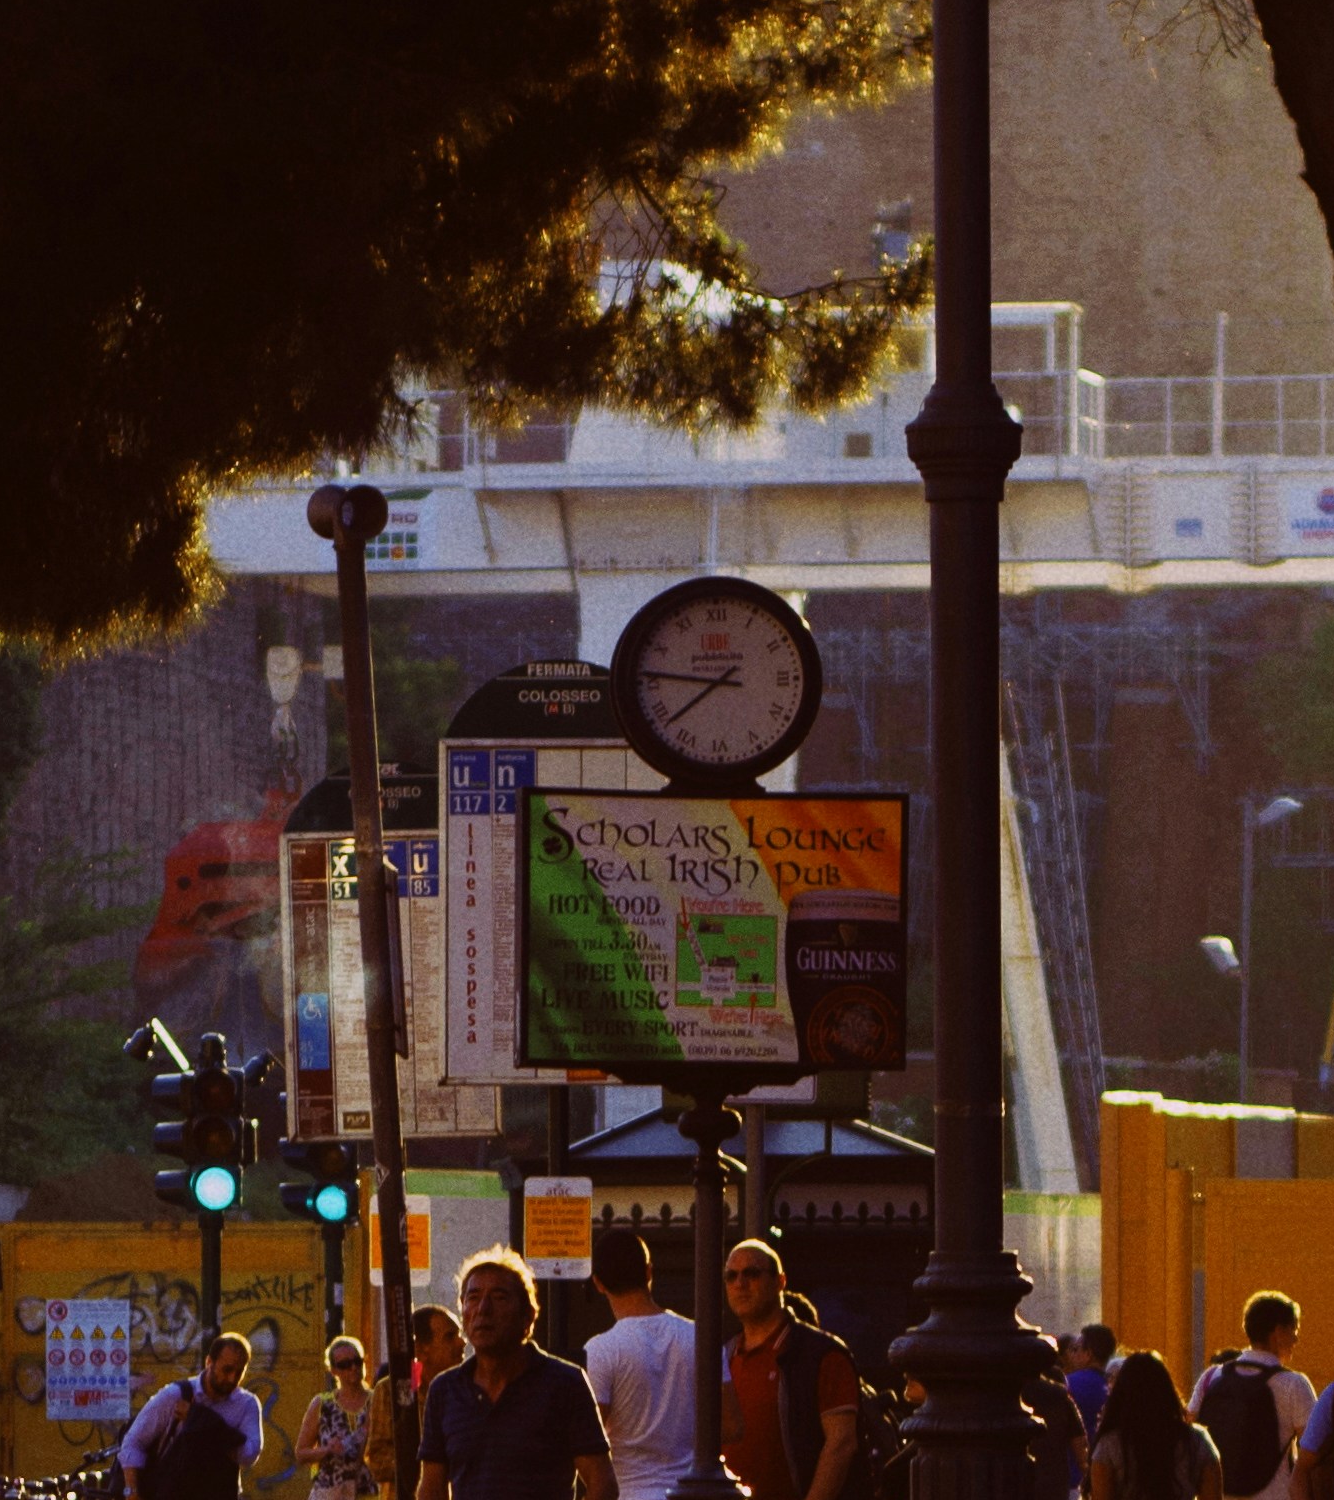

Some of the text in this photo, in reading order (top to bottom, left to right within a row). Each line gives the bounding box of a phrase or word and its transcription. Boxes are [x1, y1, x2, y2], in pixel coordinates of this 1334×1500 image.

[527, 663, 591, 677] FERMATA
[518, 689, 601, 703] COLOSSEO
[453, 795, 481, 813] 117
[466, 823, 476, 907] linea
[334, 882, 351, 899] 51
[413, 880, 430, 896] 85
[548, 894, 661, 916] HOT FOOD
[648, 916, 666, 926] DAY
[796, 946, 897, 972] GUINNESS
[565, 963, 669, 982] FREE WIFI
[466, 928, 477, 1043] sospesa
[541, 988, 669, 1010] LIVE MUSIC
[582, 1019, 639, 1036] EVERY
[643, 1020, 699, 1036] SPORT
